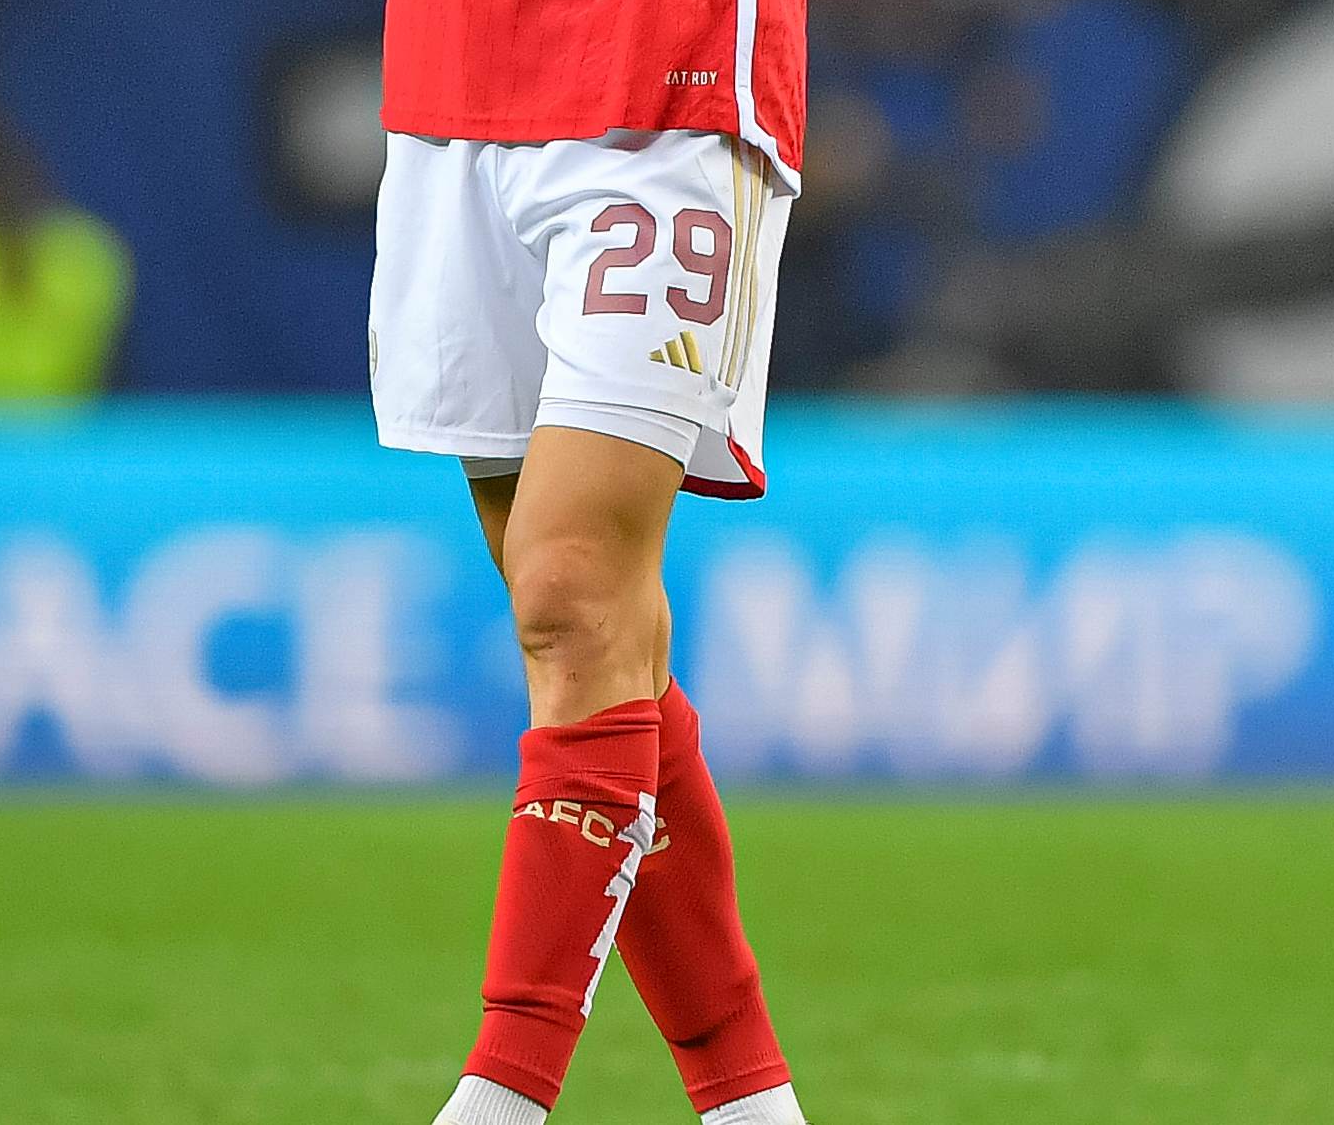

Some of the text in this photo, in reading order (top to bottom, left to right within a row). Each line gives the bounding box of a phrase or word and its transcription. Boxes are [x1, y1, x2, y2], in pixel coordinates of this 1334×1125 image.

[665, 70, 718, 86] EAT.RDY
[582, 203, 733, 326] 29
[513, 799, 615, 848] AFC
